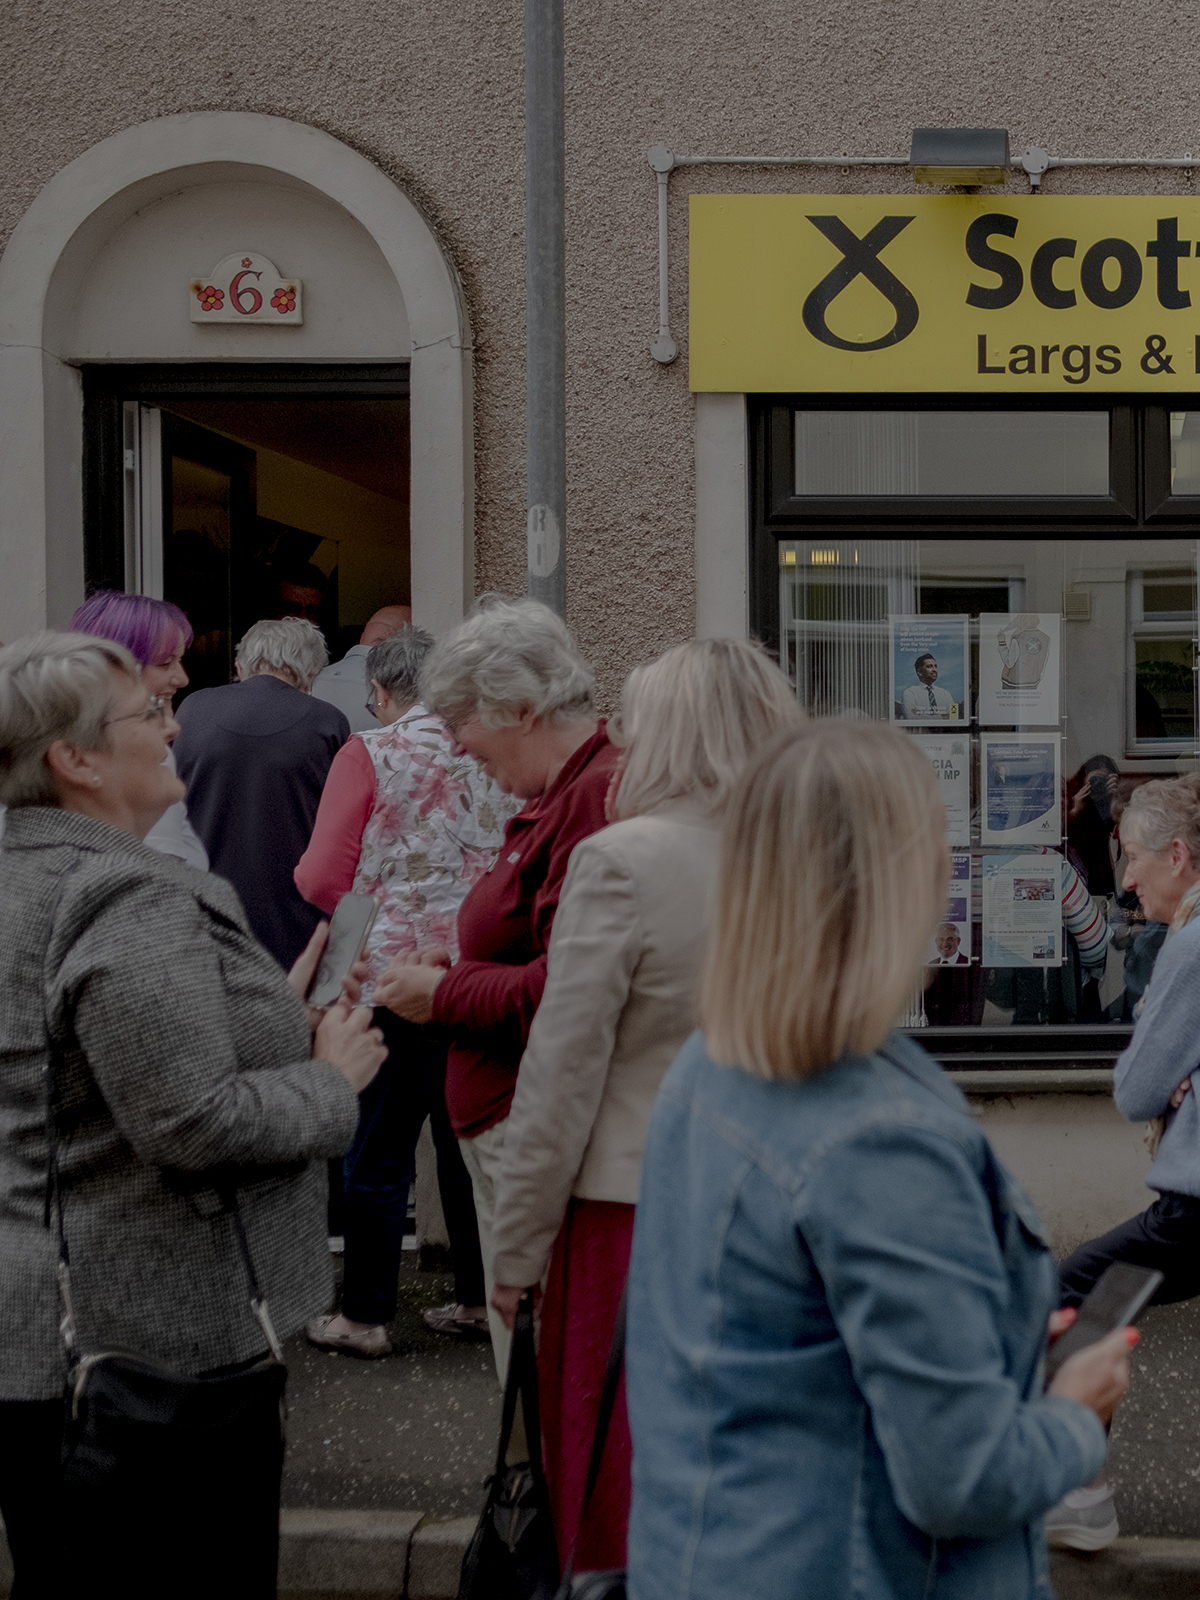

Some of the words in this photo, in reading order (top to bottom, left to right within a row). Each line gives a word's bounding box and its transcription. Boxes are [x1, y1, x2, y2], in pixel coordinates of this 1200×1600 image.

[229, 270, 263, 314] 6
[977, 334, 1122, 384] Largs
[1140, 334, 1177, 375] &
[944, 770, 960, 780] MP
